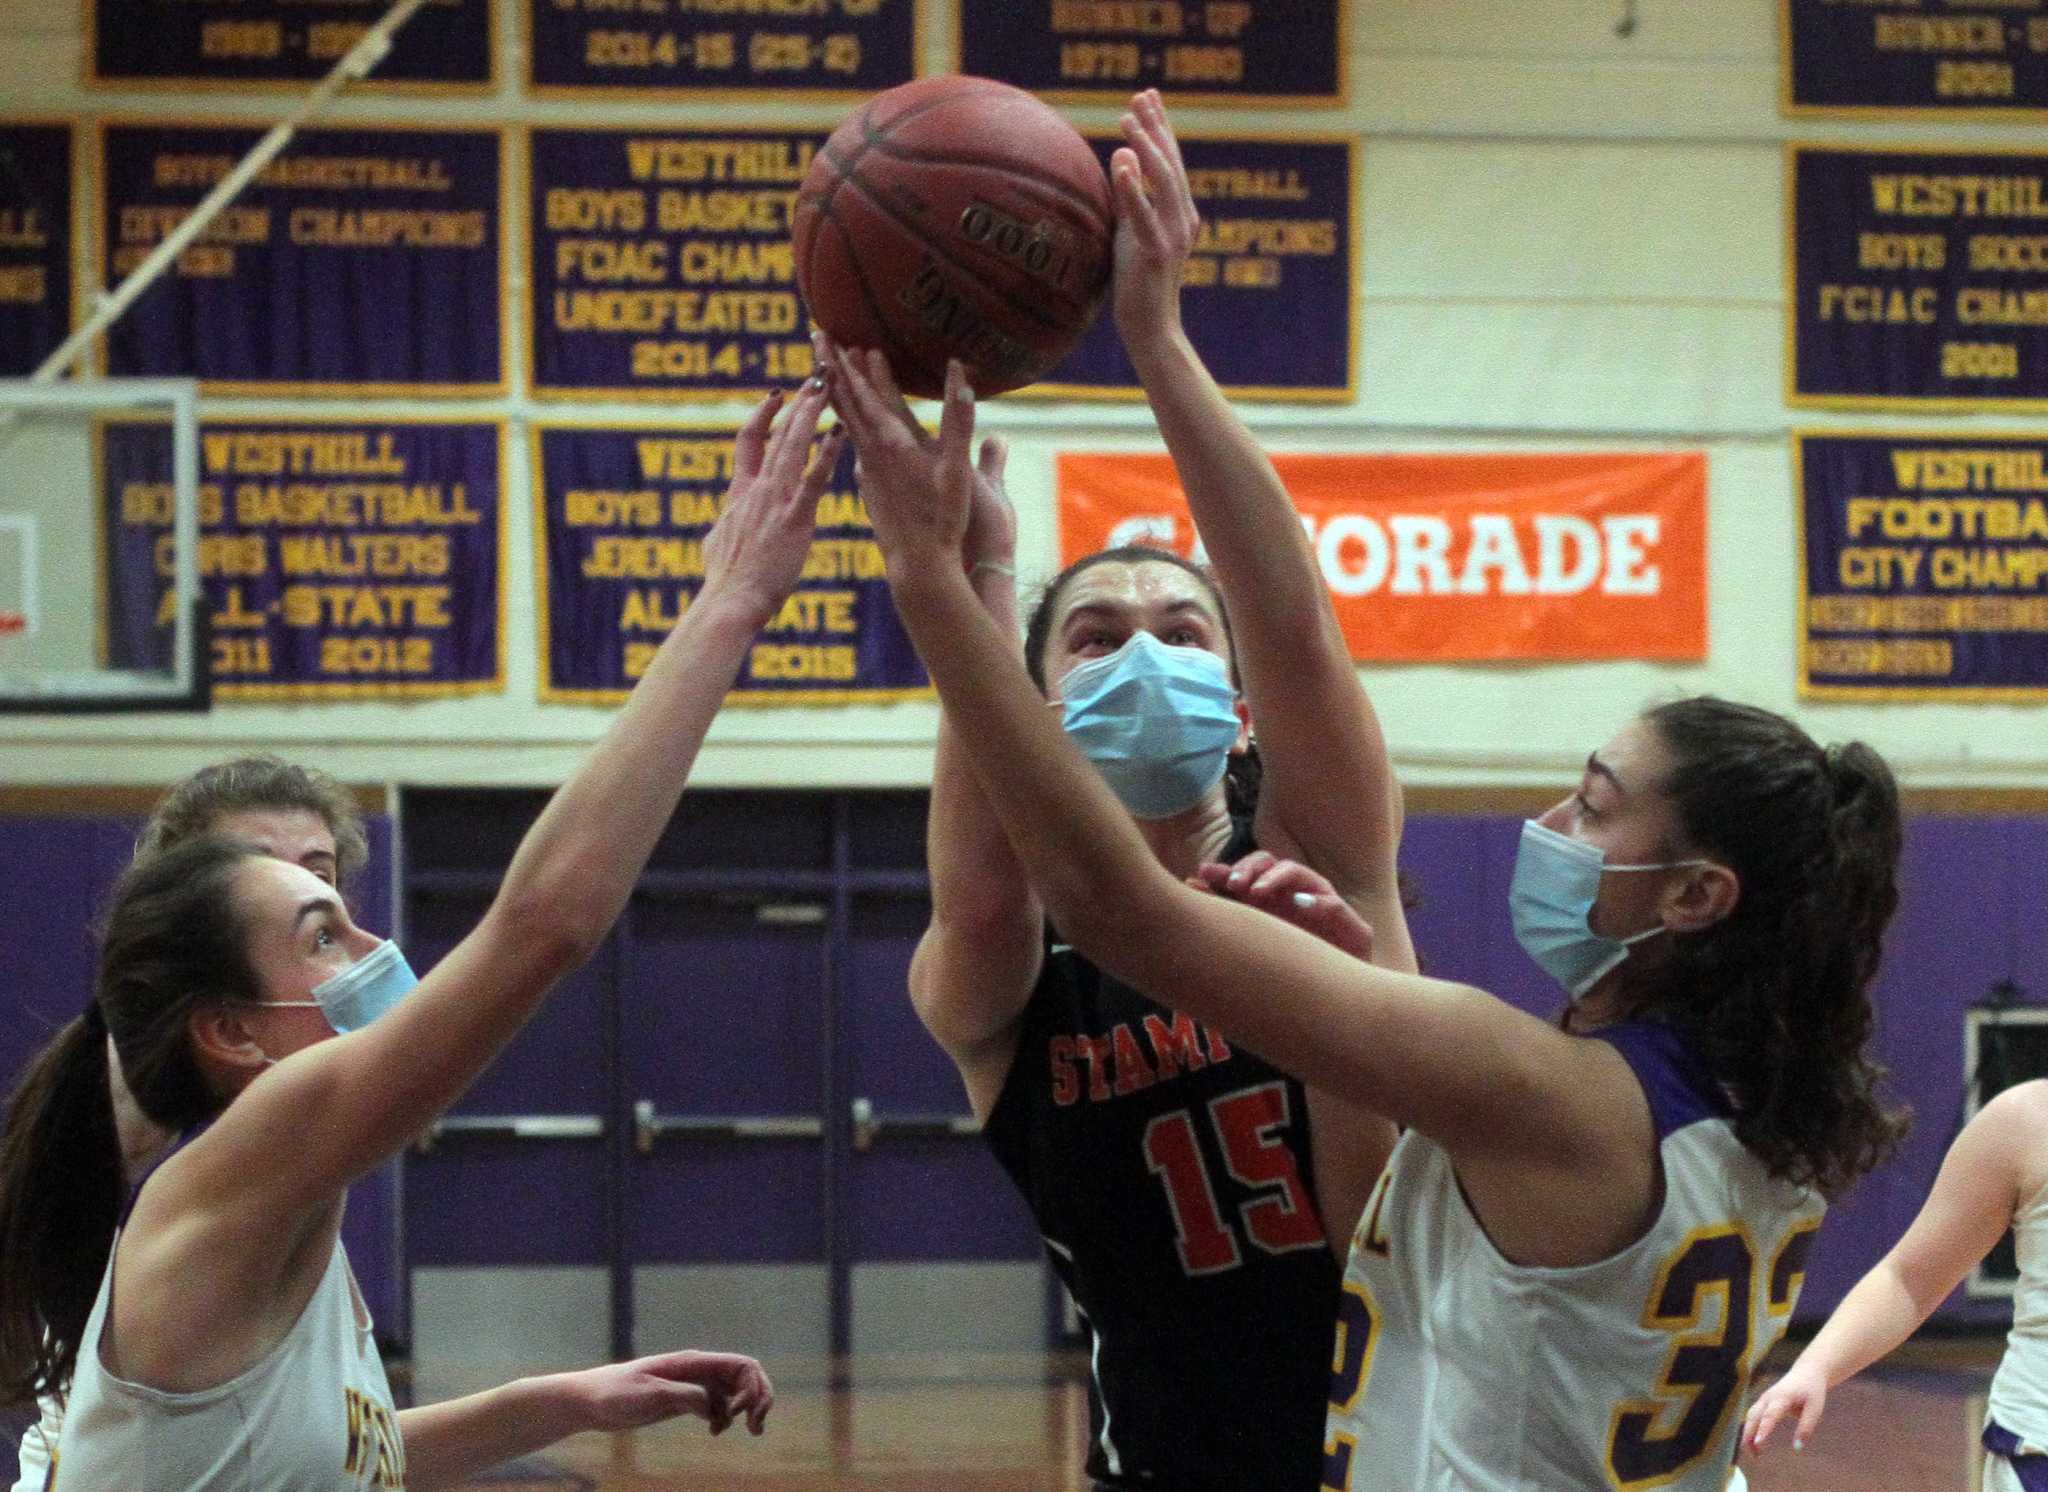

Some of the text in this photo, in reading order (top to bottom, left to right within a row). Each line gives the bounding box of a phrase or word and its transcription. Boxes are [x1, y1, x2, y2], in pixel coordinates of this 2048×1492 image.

[264, 156, 450, 190] ASKETBALL
[547, 189, 647, 230] BOYS
[554, 292, 798, 332] UNDEFEATED
[204, 433, 405, 473] WESTHILL
[122, 482, 480, 525] BOS BASKETBALL
[566, 490, 661, 525] BOYS
[155, 534, 450, 576] CRIS WALTERS
[1839, 548, 1923, 588] CITY
[320, 639, 432, 673] 2012
[1143, 1080, 1329, 1277] 15
